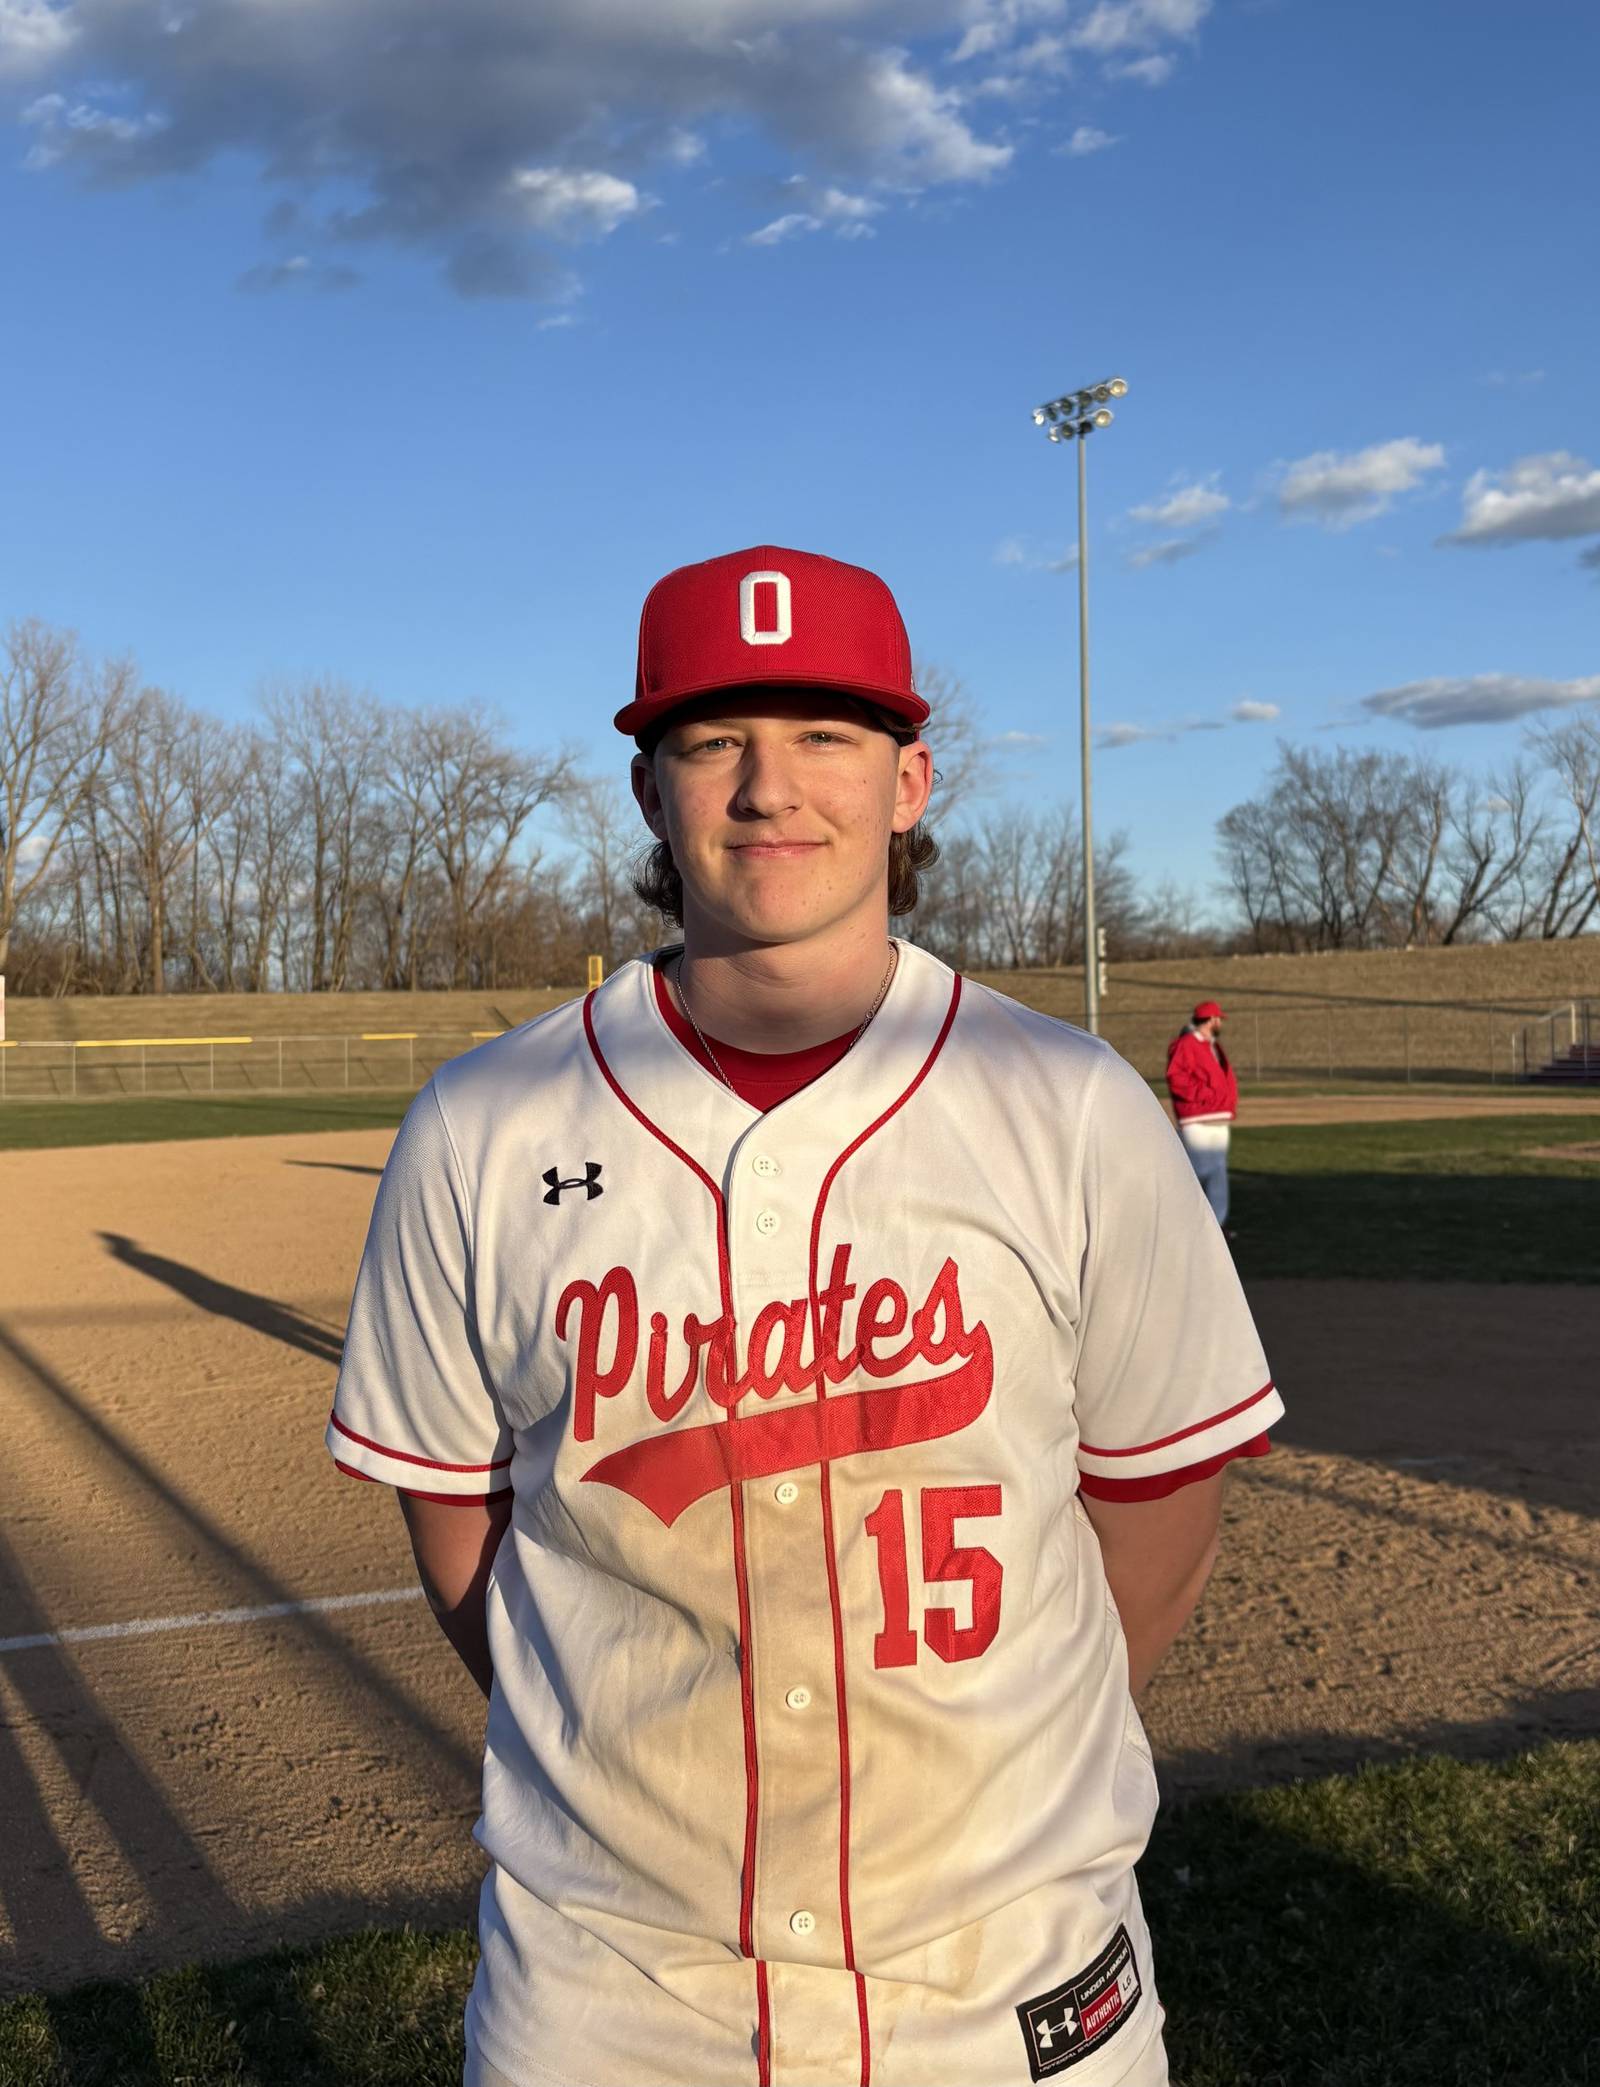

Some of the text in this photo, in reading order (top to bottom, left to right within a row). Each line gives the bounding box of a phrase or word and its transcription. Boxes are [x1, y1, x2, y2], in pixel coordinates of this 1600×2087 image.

[555, 1244, 984, 1442] Pirates
[864, 1484, 1003, 1670] 15
[1080, 1976, 1106, 2001] UNDER
[1122, 1974, 1132, 1992] LG
[1086, 1991, 1120, 2032] AUTHENTIC
